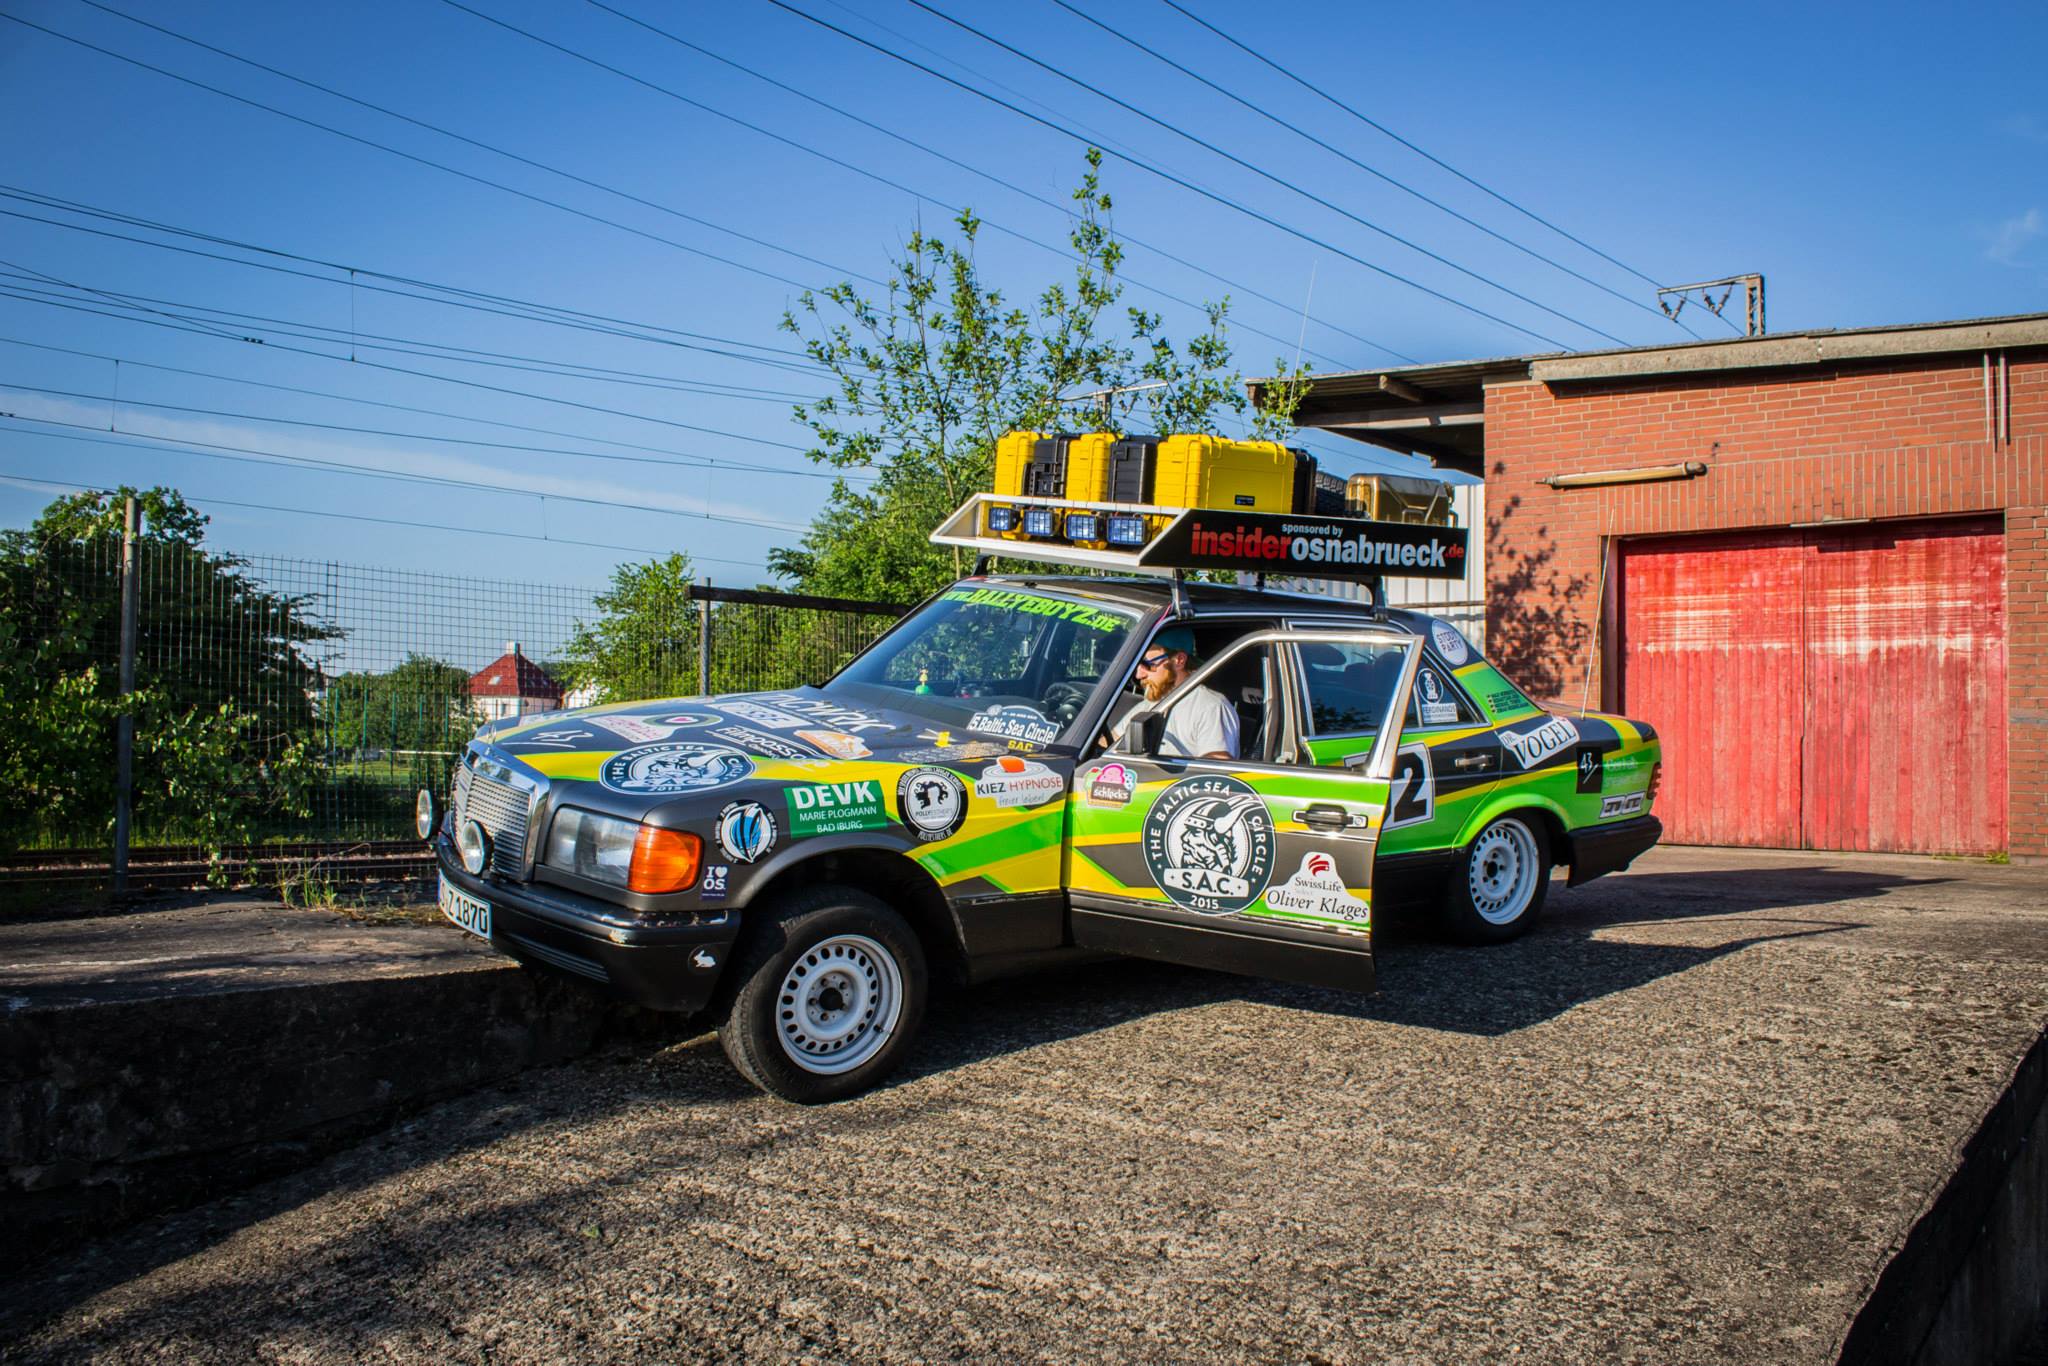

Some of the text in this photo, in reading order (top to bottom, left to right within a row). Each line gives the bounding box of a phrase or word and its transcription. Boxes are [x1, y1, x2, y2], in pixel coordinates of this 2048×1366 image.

[1281, 523, 1344, 538] sponsored by
[1005, 719, 1025, 737] Sea
[1024, 722, 1054, 744] Circle
[1007, 740, 1034, 752] SAC
[1513, 721, 1577, 765] VOGEL
[792, 781, 877, 810] DEVK
[977, 777, 1062, 795] KIEZ HYPNOSE
[1204, 781, 1230, 796] SEA
[1155, 783, 1200, 822] BALTIC
[800, 807, 877, 822] MARIE PLOGMANN
[816, 821, 864, 833] BAD IBURG
[1150, 828, 1163, 860] THE
[1181, 871, 1234, 895] S.A.C.
[1190, 895, 1219, 910] 2015
[1267, 890, 1368, 921] Oliver Klages
